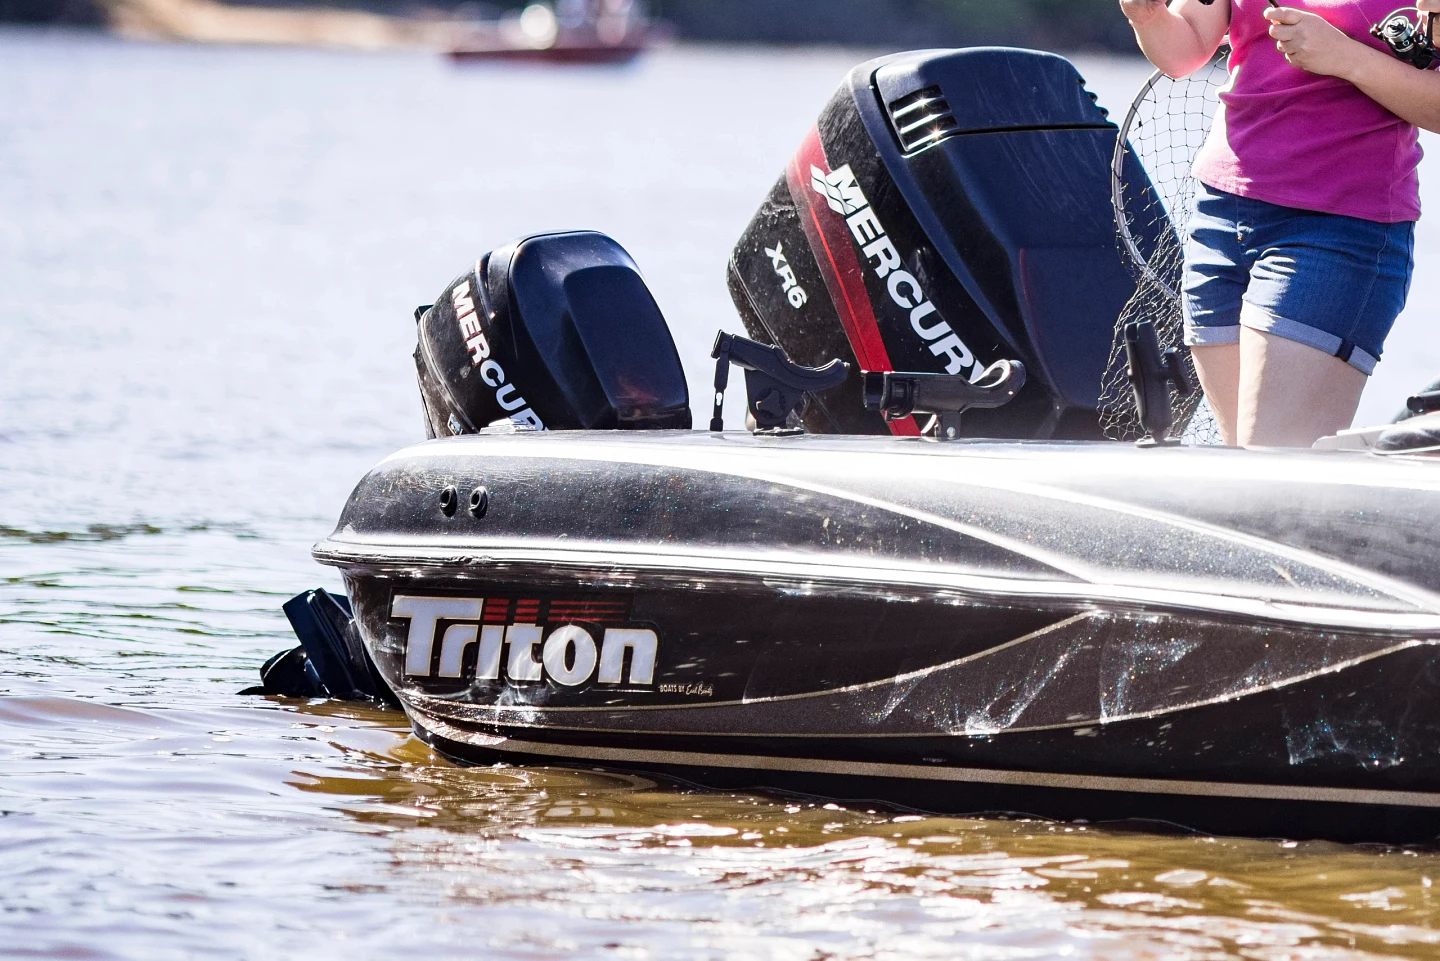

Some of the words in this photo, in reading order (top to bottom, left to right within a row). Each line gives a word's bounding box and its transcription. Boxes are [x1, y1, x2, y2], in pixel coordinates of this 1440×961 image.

[765, 241, 808, 310] XR6
[452, 279, 549, 431] MERCUR
[391, 595, 658, 686] Triton
